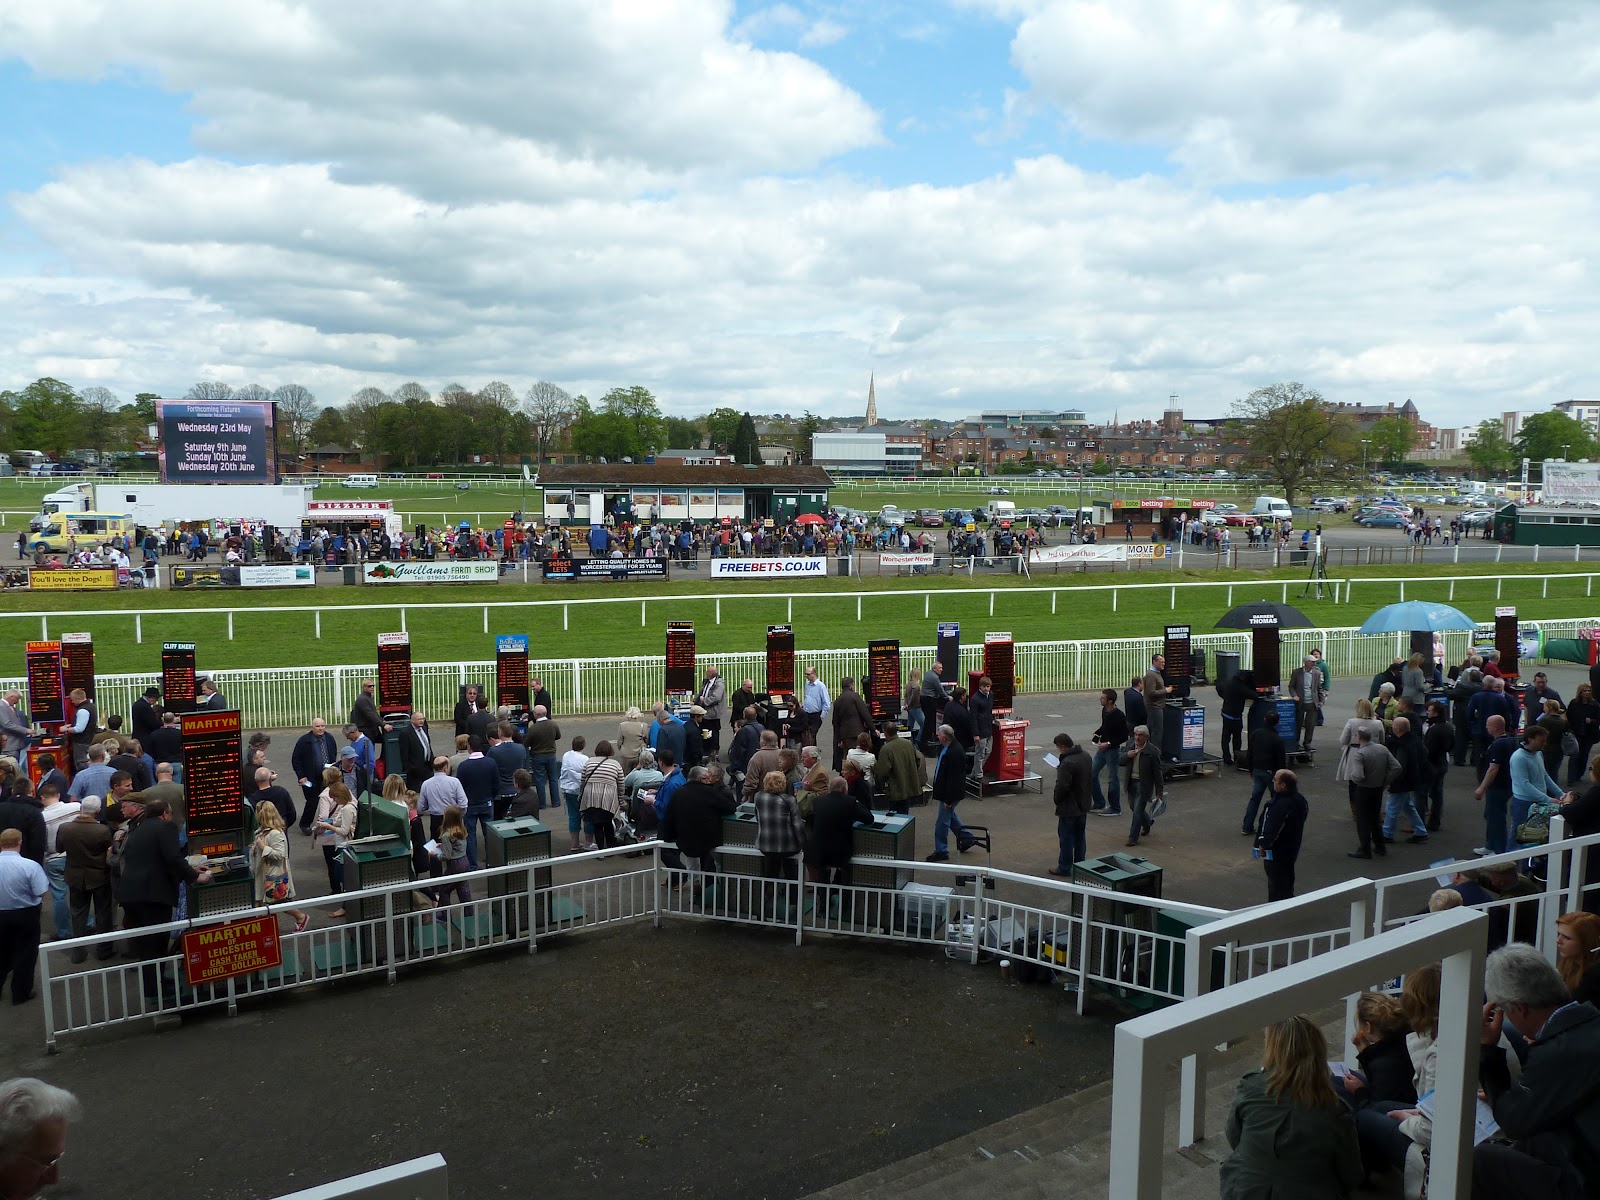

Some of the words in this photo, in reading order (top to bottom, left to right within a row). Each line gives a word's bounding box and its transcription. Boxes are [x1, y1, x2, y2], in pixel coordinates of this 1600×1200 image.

[187, 405, 219, 413] Forthcoming
[178, 423, 218, 434] Wednesday
[220, 423, 235, 432] 23rd
[237, 424, 251, 434] May
[184, 443, 215, 453] Saturday
[217, 443, 228, 451] 9th
[230, 443, 247, 451] June
[186, 453, 212, 462] Sunday
[213, 453, 228, 461] 10th
[230, 453, 246, 461] June
[178, 462, 218, 473] Wednesday
[220, 462, 237, 471] 20th
[239, 463, 255, 471] June
[548, 559, 572, 567] select
[719, 561, 821, 572] FREEBETS.CO.UK
[395, 563, 449, 578] Gwillams
[451, 566, 472, 574] FARM
[82, 575, 102, 583] Dogs!
[184, 717, 237, 730] MARTYN
[203, 846, 216, 854] WIN
[217, 843, 233, 852] ONLY
[200, 922, 262, 945] MARTYN
[227, 937, 236, 946] OF
[208, 940, 257, 958] LEICESTER
[210, 956, 231, 968] CASH
[233, 950, 258, 962] TAKEN
[231, 956, 267, 971] DOLLARS
